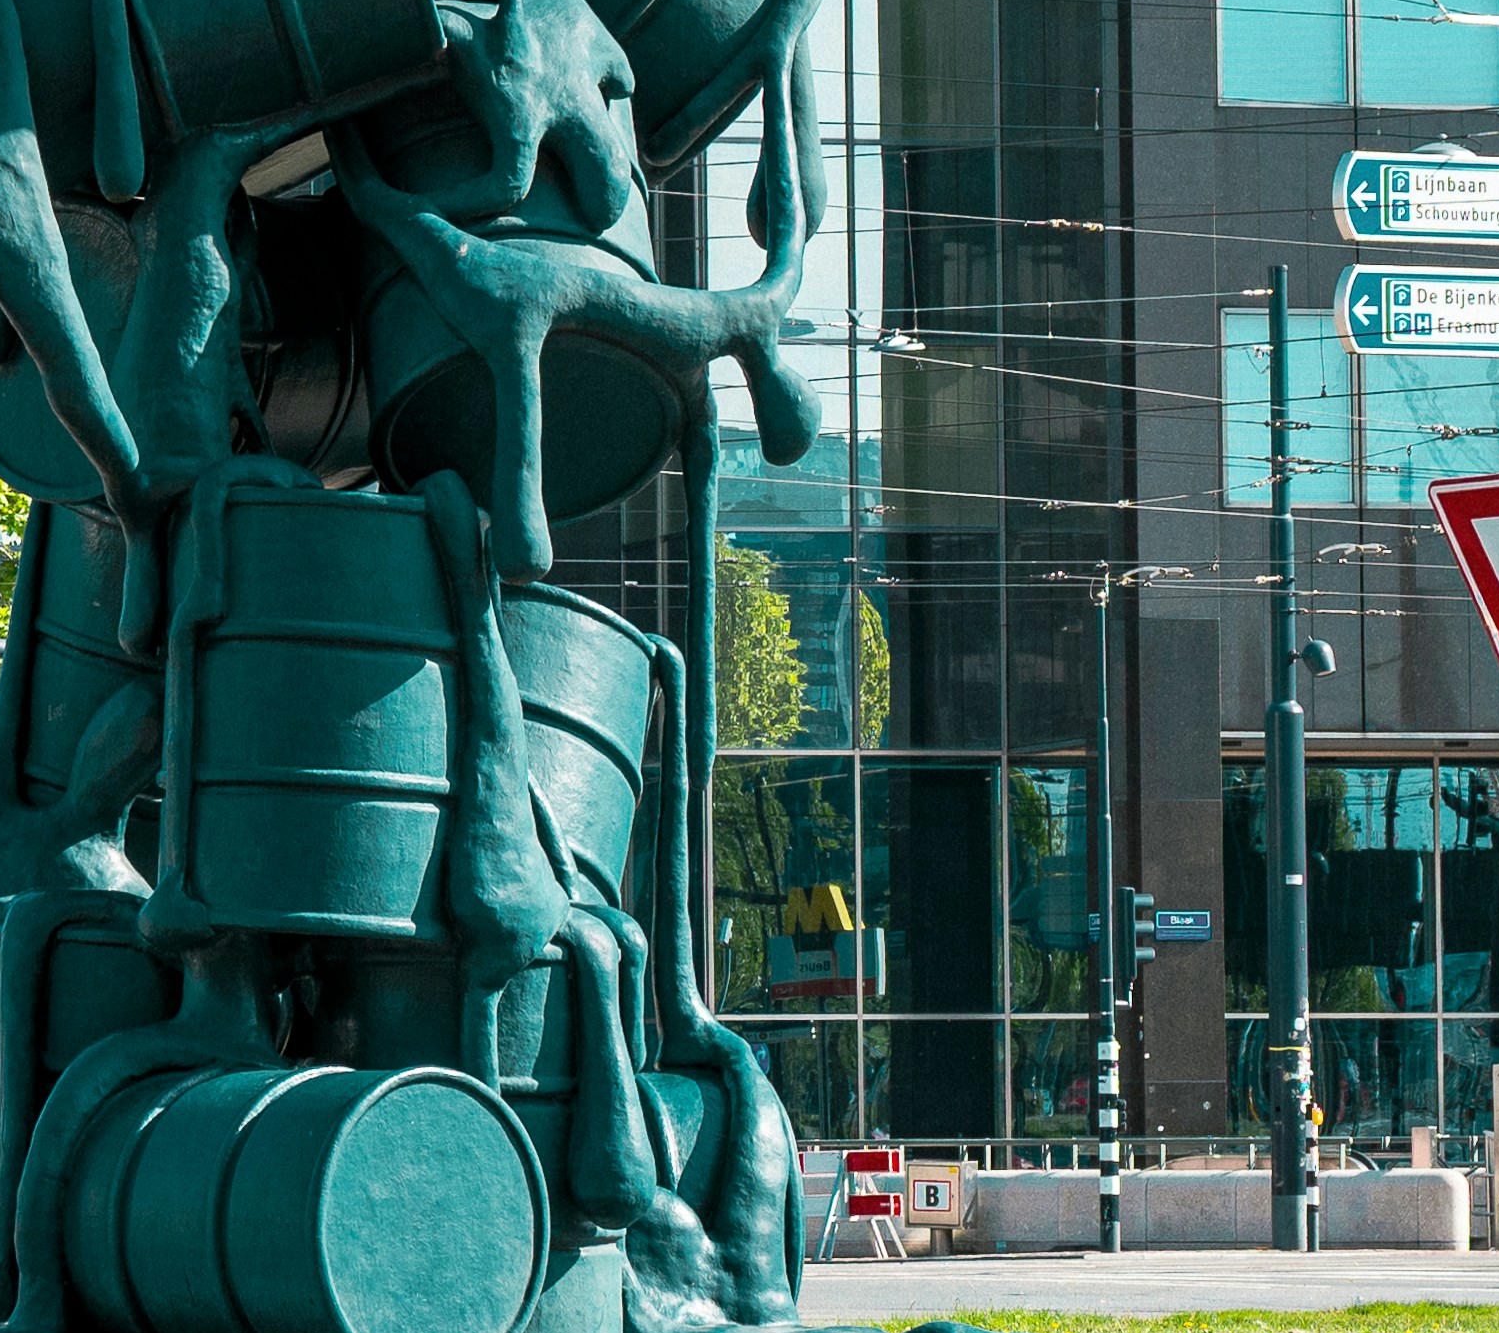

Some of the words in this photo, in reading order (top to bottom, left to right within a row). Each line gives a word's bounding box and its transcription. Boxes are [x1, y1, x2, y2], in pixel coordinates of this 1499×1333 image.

[1415, 174, 1488, 196] Lijnbaan
[1417, 287, 1438, 305] De
[926, 1185, 939, 1207] B
